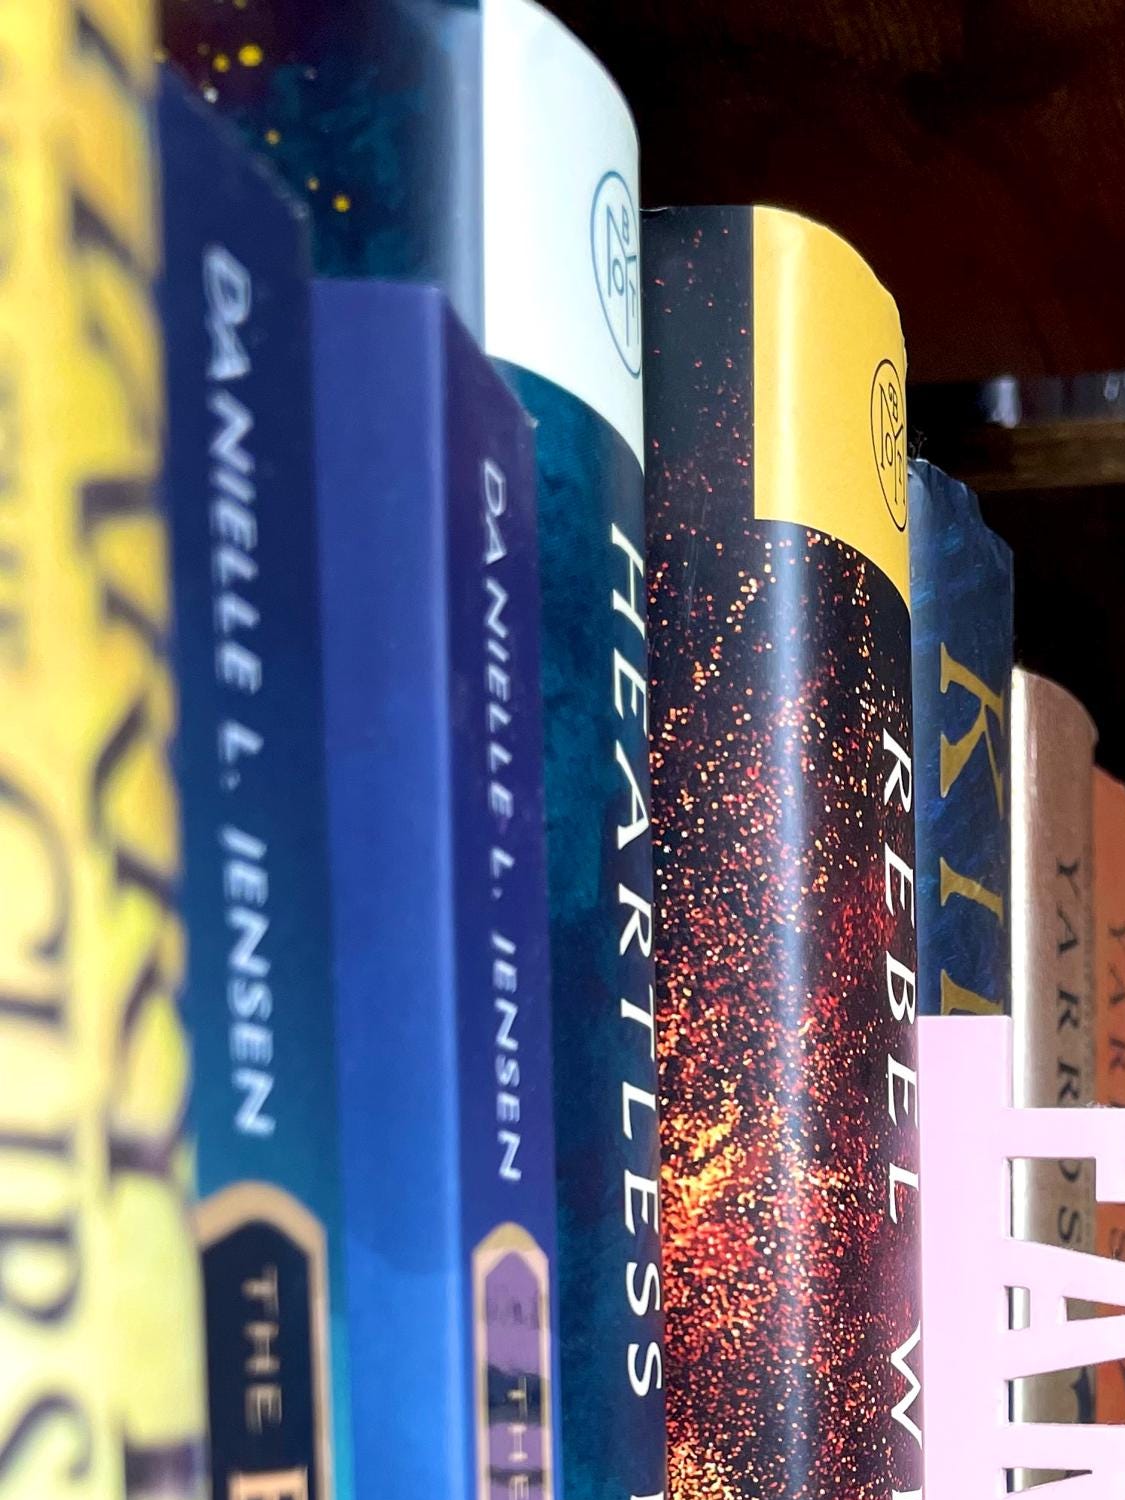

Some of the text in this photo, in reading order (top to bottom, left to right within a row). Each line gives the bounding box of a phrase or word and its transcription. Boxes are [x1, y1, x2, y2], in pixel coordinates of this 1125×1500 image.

[203, 243, 264, 694] DANIELLE
[484, 458, 512, 818] DANIELLE
[220, 825, 276, 1138] JENSEN
[493, 930, 521, 1182] JENSEN
[610, 522, 663, 1397] HEARTLESS
[882, 727, 921, 1226] REBEL
[240, 1263, 282, 1434] THE
